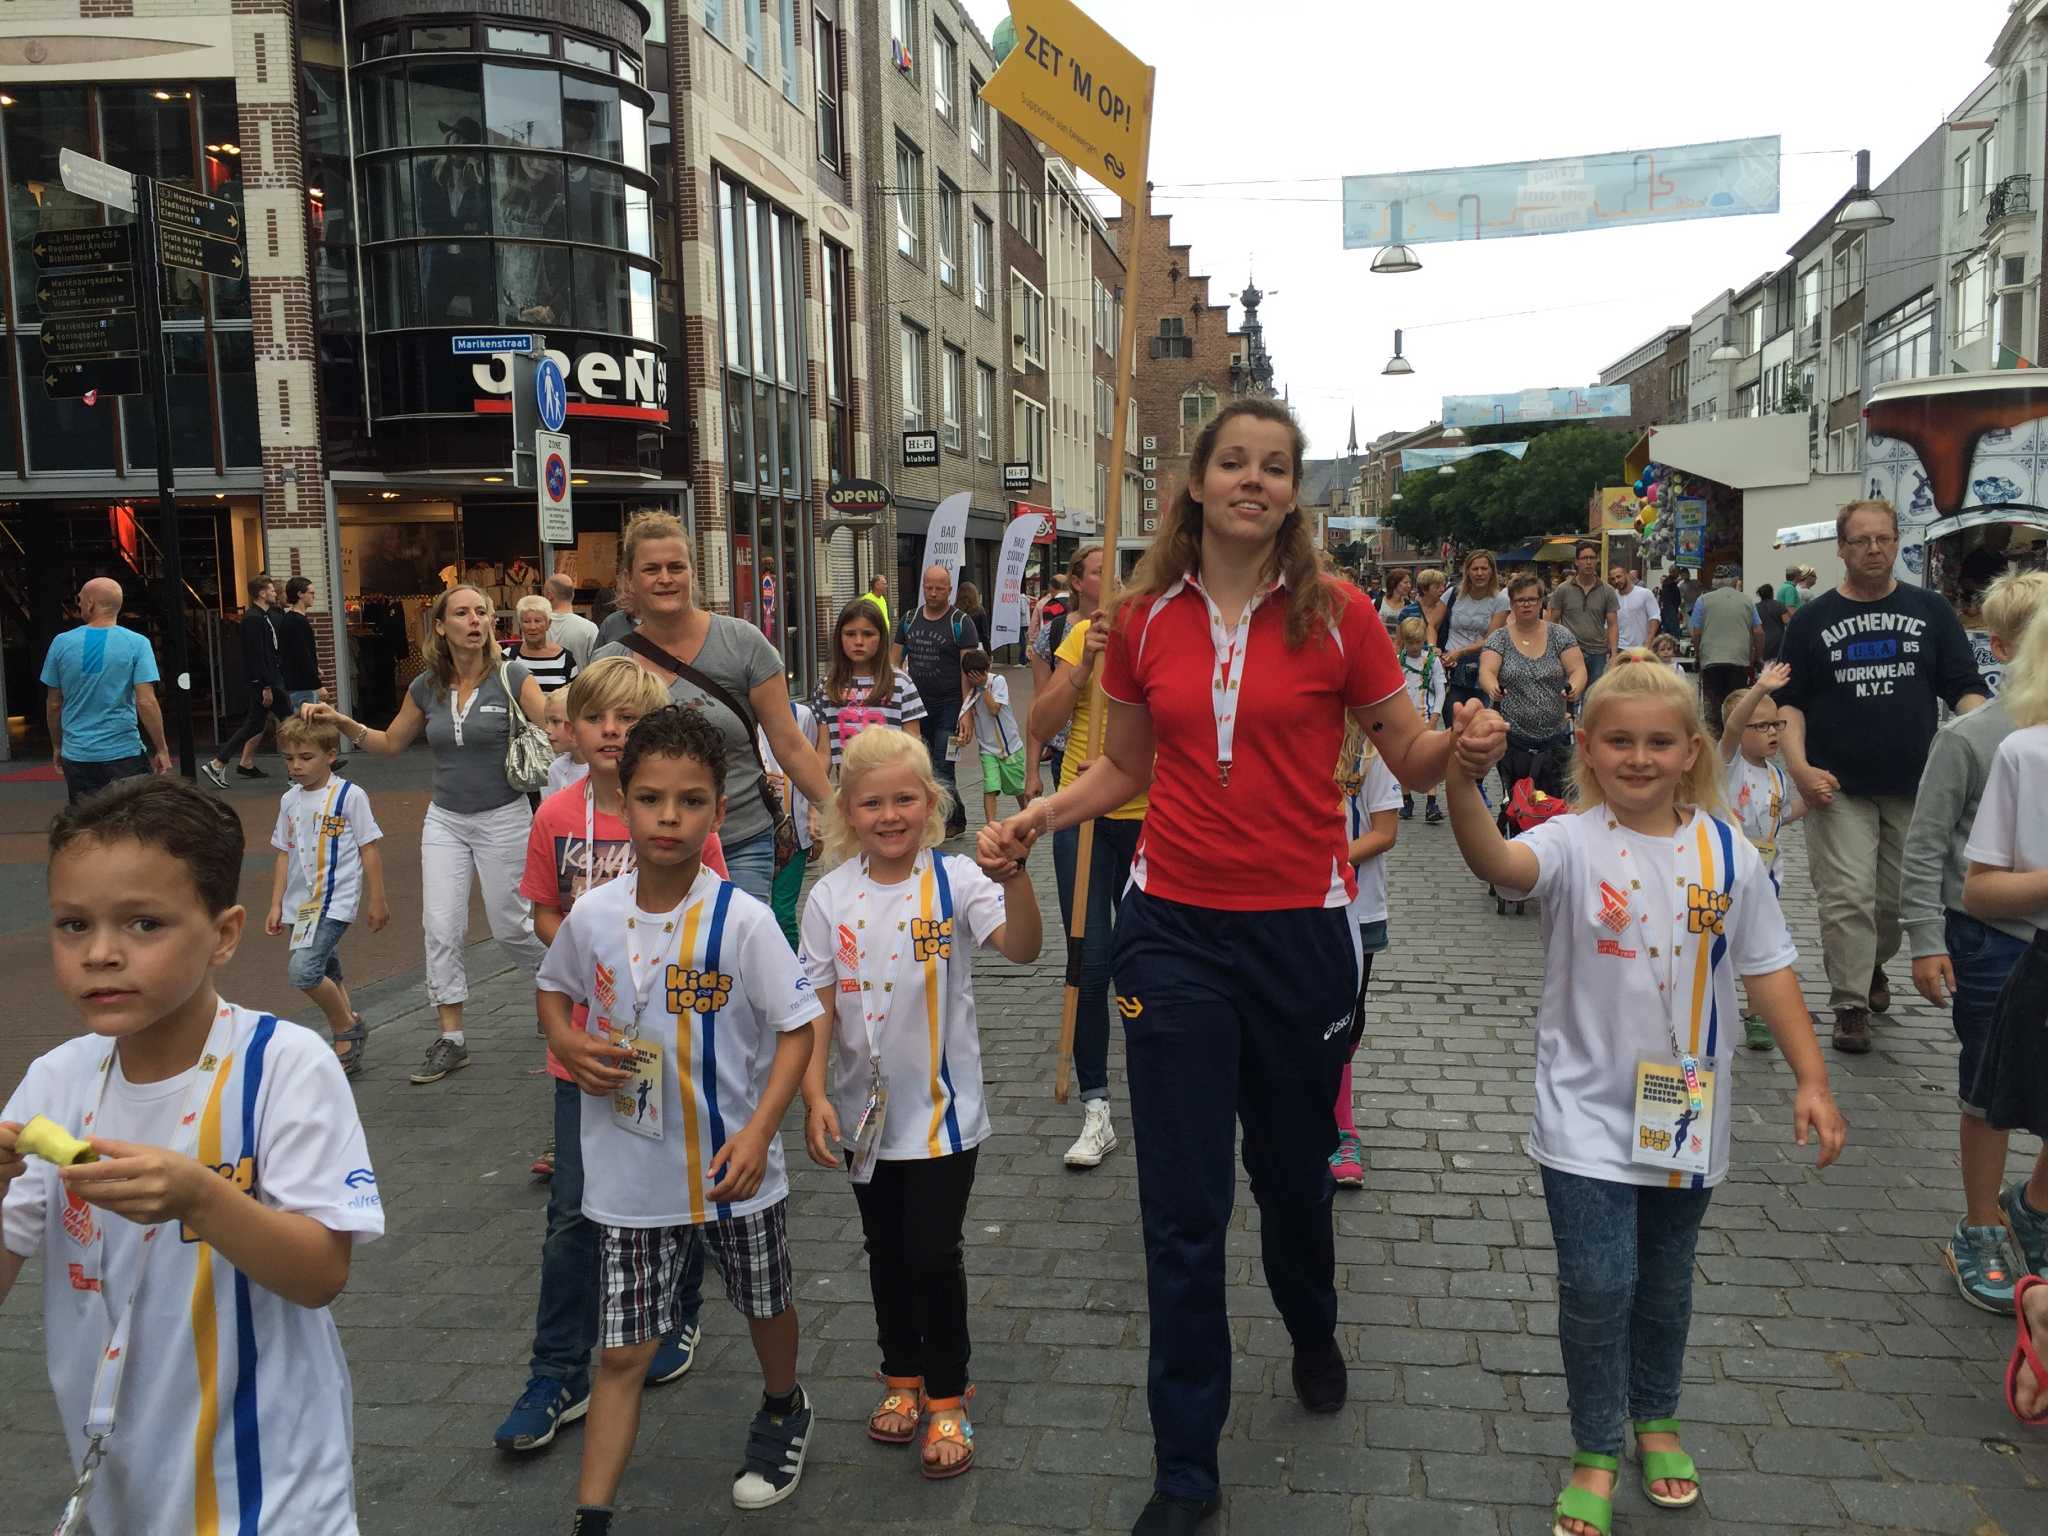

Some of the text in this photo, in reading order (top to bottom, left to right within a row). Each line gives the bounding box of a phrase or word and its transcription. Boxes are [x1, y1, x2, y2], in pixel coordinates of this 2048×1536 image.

[1023, 25, 1064, 77] ZET
[1098, 85, 1131, 133] OP!
[457, 338, 527, 349] Marikenstraat
[907, 437, 934, 450] Hi-Fi
[906, 454, 936, 464] klubben
[1007, 468, 1028, 478] Hi-Fi
[1006, 479, 1029, 488] klubben
[1145, 437, 1155, 530] SHOES
[940, 525, 956, 539] BAD
[736, 547, 752, 566] ALE
[933, 542, 959, 556] SOUND
[1821, 612, 1927, 648] AUTHENTIC
[1830, 650, 1842, 662] 19
[1902, 641, 1920, 653] 85
[1834, 662, 1916, 683] WORKWEAR
[1856, 681, 1894, 697] N.Y.C
